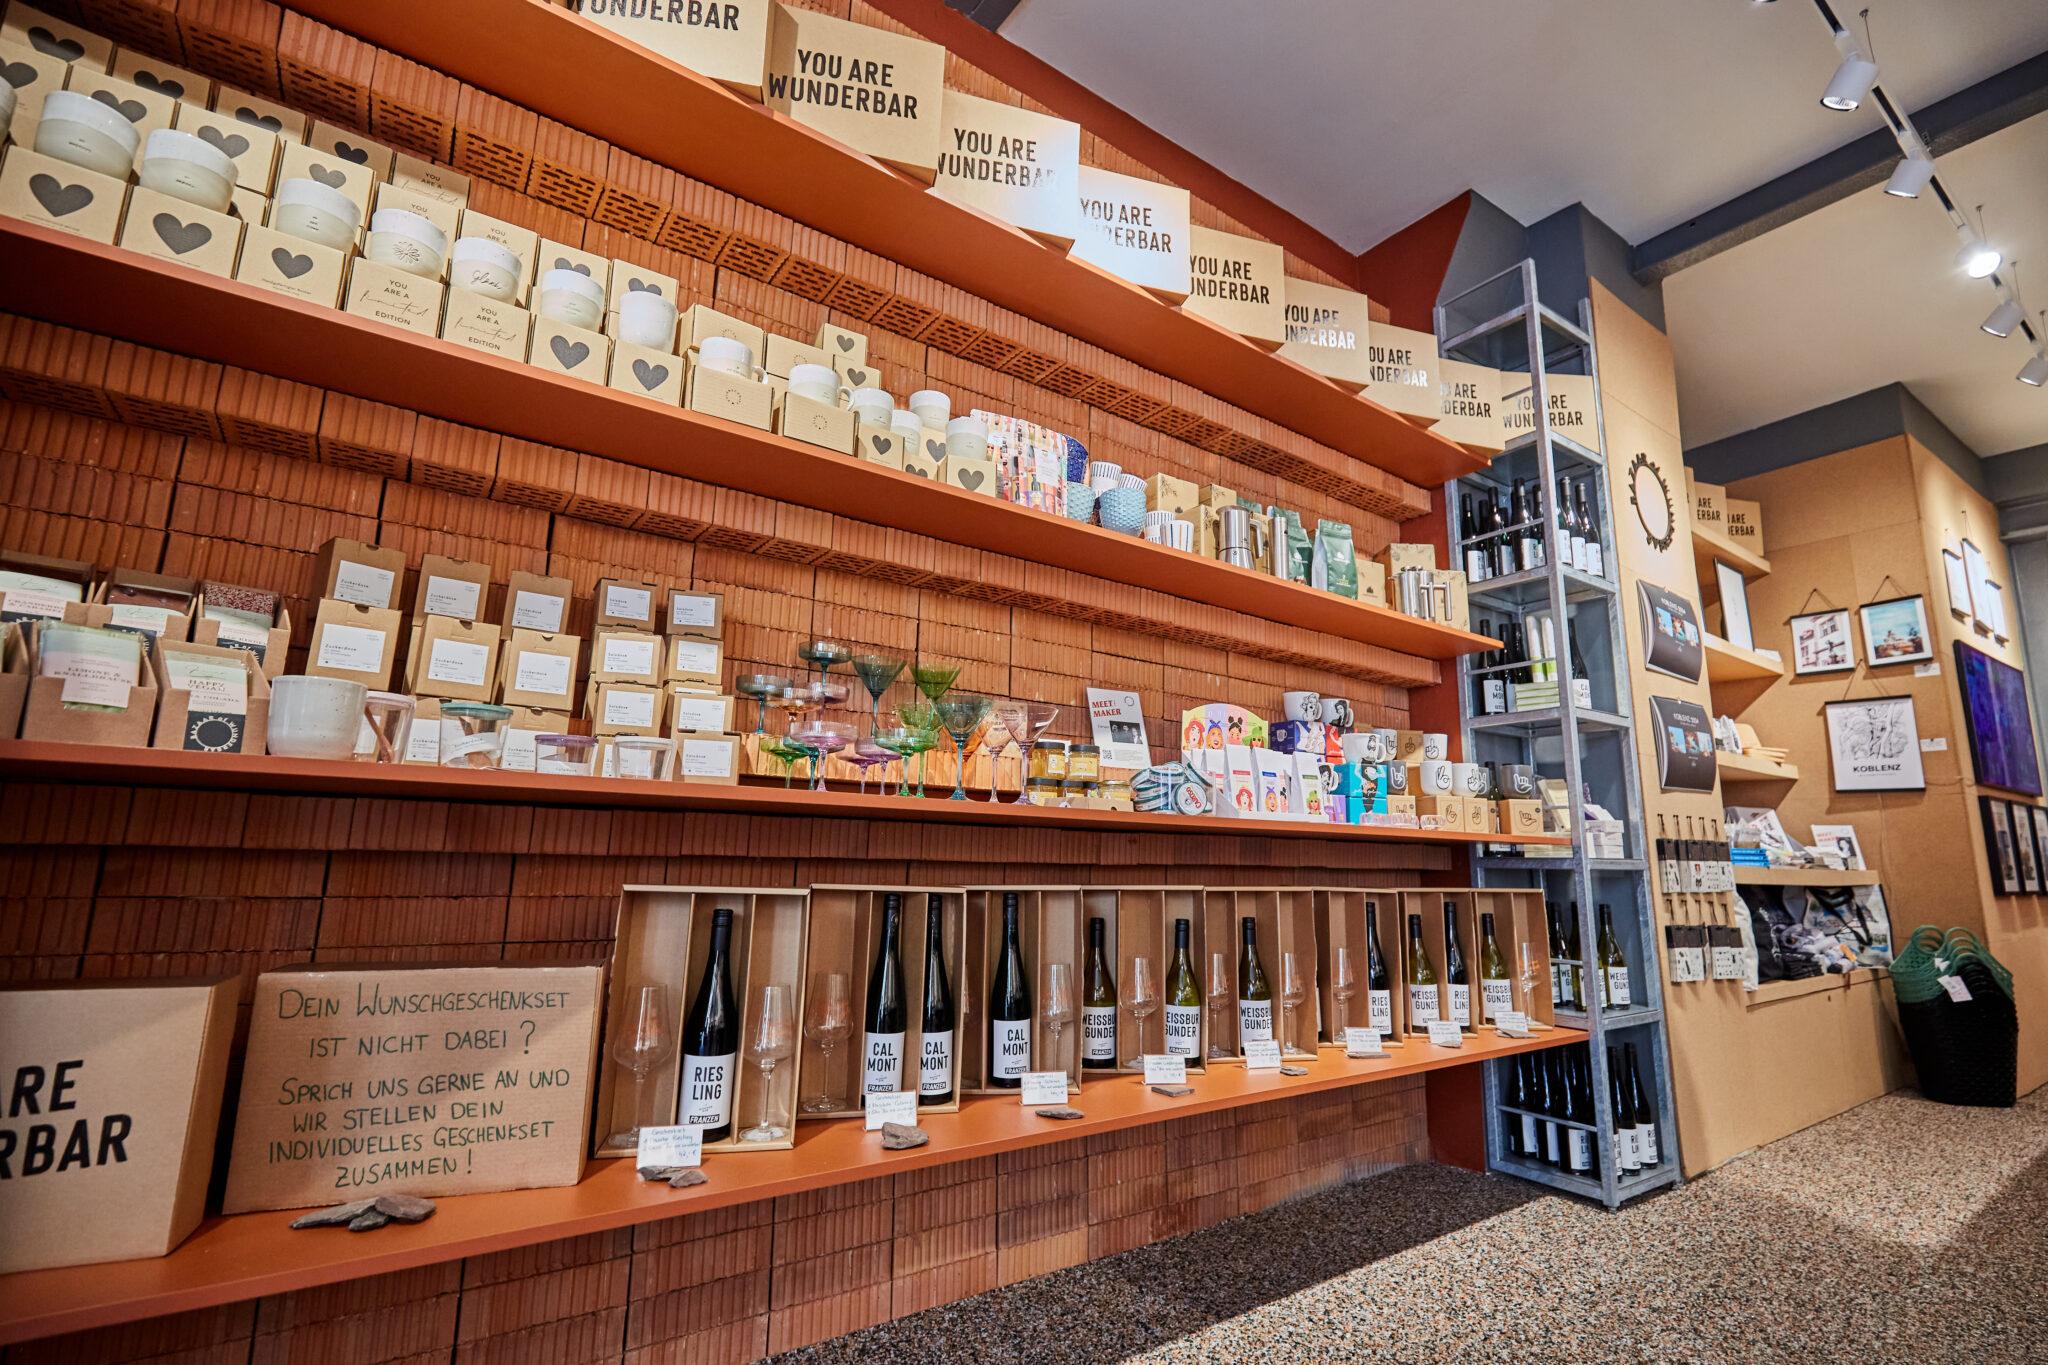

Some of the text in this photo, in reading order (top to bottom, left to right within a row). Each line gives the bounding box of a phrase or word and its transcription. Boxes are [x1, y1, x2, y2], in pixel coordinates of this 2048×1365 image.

[797, 49, 894, 88] YOU ARE
[768, 73, 919, 120] WUNDERBAR
[953, 128, 1037, 163] YOU ARE
[424, 171, 441, 182] YOU
[1080, 197, 1153, 228] YOU ARE
[490, 226, 506, 237] YOU
[1189, 255, 1252, 281] YOU ARE
[389, 279, 408, 290] YOU
[383, 286, 410, 300] ARE A
[375, 310, 411, 327] EDITION
[476, 313, 493, 323] ARE
[480, 306, 498, 317] YOU
[1284, 304, 1340, 328] YOU ARE
[468, 336, 501, 351] EDITION
[1369, 346, 1413, 366] OU ARE
[1454, 383, 1478, 400] ARE
[1092, 700, 1113, 709] MEET
[1093, 708, 1122, 717] MAKER
[1853, 764, 1901, 773] KOBLENZ
[1371, 996, 1389, 1007] RIES
[1372, 1007, 1389, 1018] LING
[309, 1019, 536, 1058] IST NICHT DABEI ?
[1007, 1029, 1025, 1042] CAL
[873, 1042, 893, 1056] CAL
[925, 1041, 945, 1055] CAL
[1002, 1041, 1029, 1056] MONT
[867, 1057, 898, 1072] MONT
[920, 1056, 948, 1071] MONT
[694, 1066, 724, 1083] RIES
[0, 1060, 84, 1118] RE
[367, 1078, 409, 1099] UNS
[417, 1073, 485, 1096] GERNE
[494, 1069, 519, 1090] AN
[529, 1068, 571, 1089] UND
[867, 1084, 894, 1093] FRANZEN
[921, 1081, 947, 1091] FRANZEN
[692, 1084, 722, 1101] LING
[292, 1100, 504, 1134] WIR STELLEN DEIN
[688, 1113, 720, 1125] FRANZEN
[268, 1120, 556, 1164] INDIVIDUELLES GESCHENKSET
[334, 1156, 458, 1189] ZUSAMMEN
